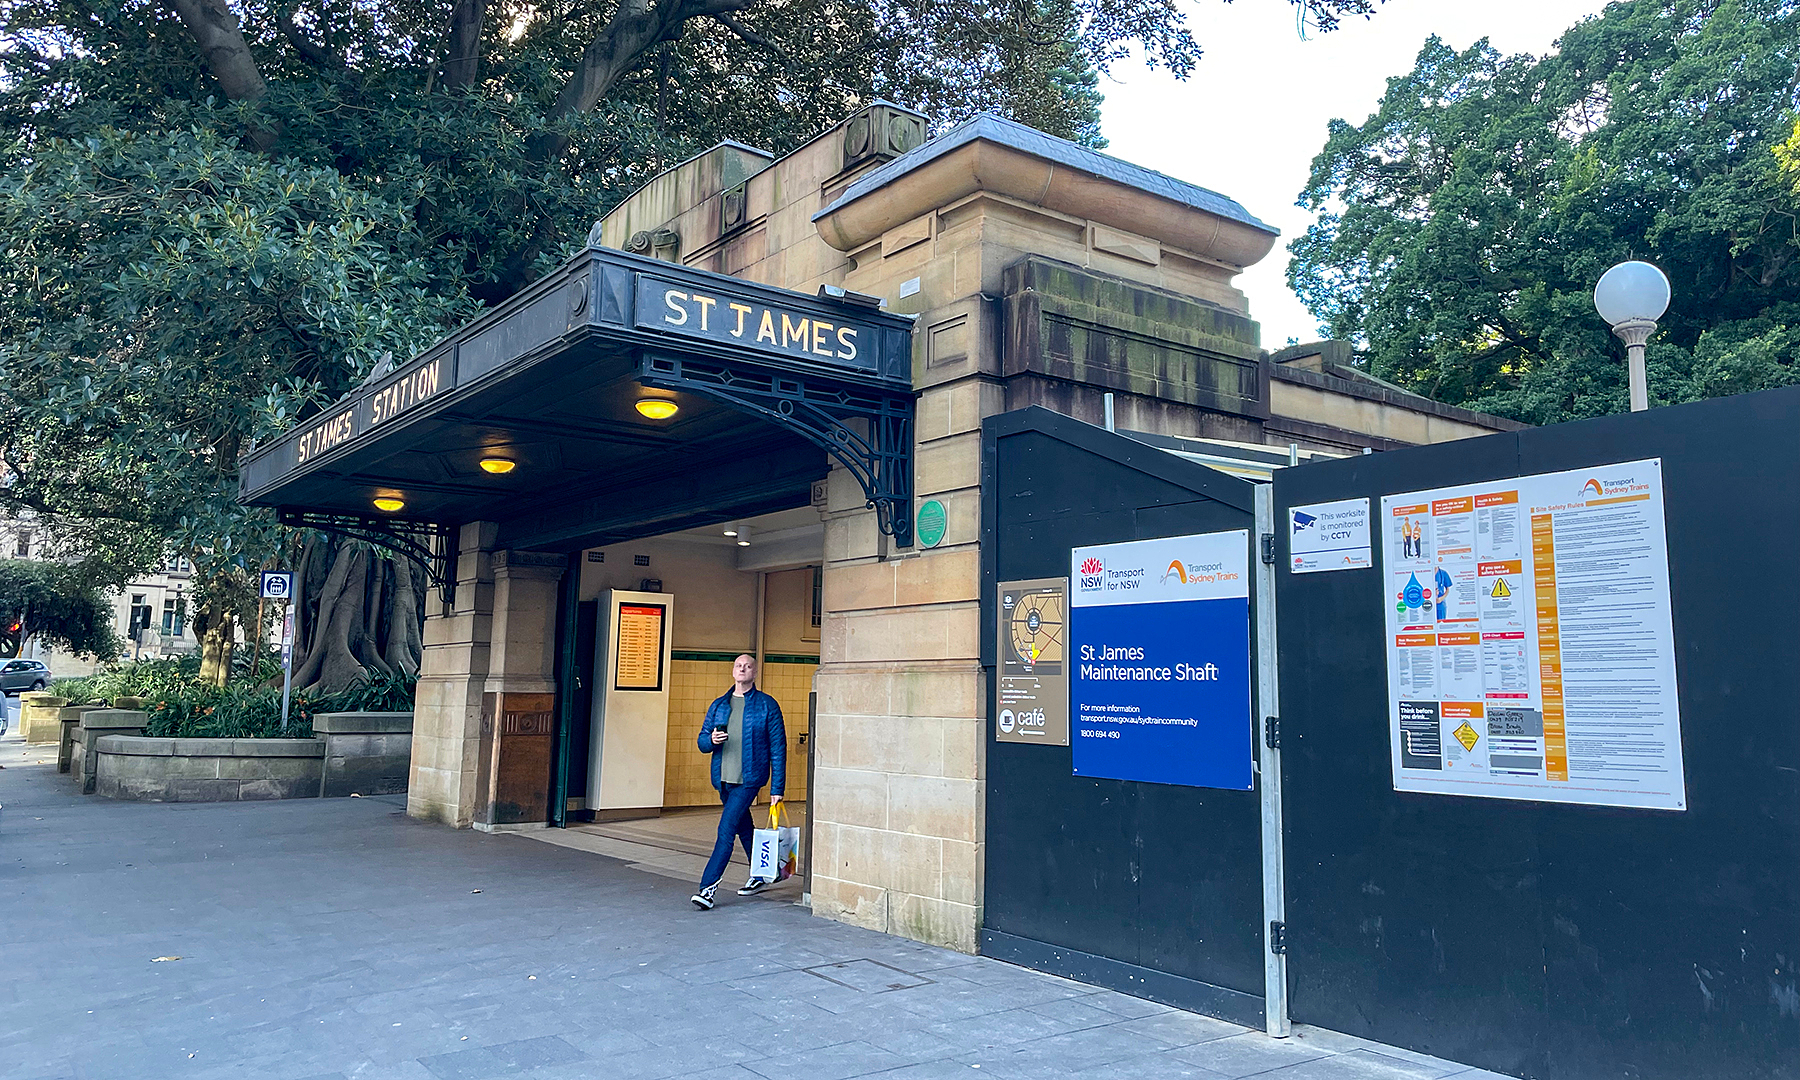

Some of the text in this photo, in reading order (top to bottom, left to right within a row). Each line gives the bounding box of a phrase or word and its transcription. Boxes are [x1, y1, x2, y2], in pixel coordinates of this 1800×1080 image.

[664, 290, 858, 361] ST JAMES
[298, 359, 440, 463] ST JAMES STATION
[1603, 477, 1634, 487] Transport
[1604, 483, 1649, 495] Sydney Trains
[1548, 503, 1566, 512] Safety
[1567, 501, 1584, 509] Rules
[1335, 509, 1366, 519] worksite
[1327, 520, 1363, 530] monitored
[1321, 531, 1351, 542] by CCTV
[1188, 562, 1222, 573] Transport
[1107, 568, 1144, 579] Transport
[1189, 572, 1238, 584] Sydney Trains
[1081, 576, 1103, 588] NSW
[1107, 580, 1140, 590] for NSW
[1080, 644, 1144, 661] St James
[1080, 662, 1218, 680] Maintenance Shaft
[1107, 704, 1140, 713] information
[1017, 707, 1046, 727] café
[1080, 715, 1198, 728] transport.nsw.gov.au/sydtraincommunity
[1080, 729, 1121, 739] 1800 694 490
[760, 840, 770, 868] VISA
